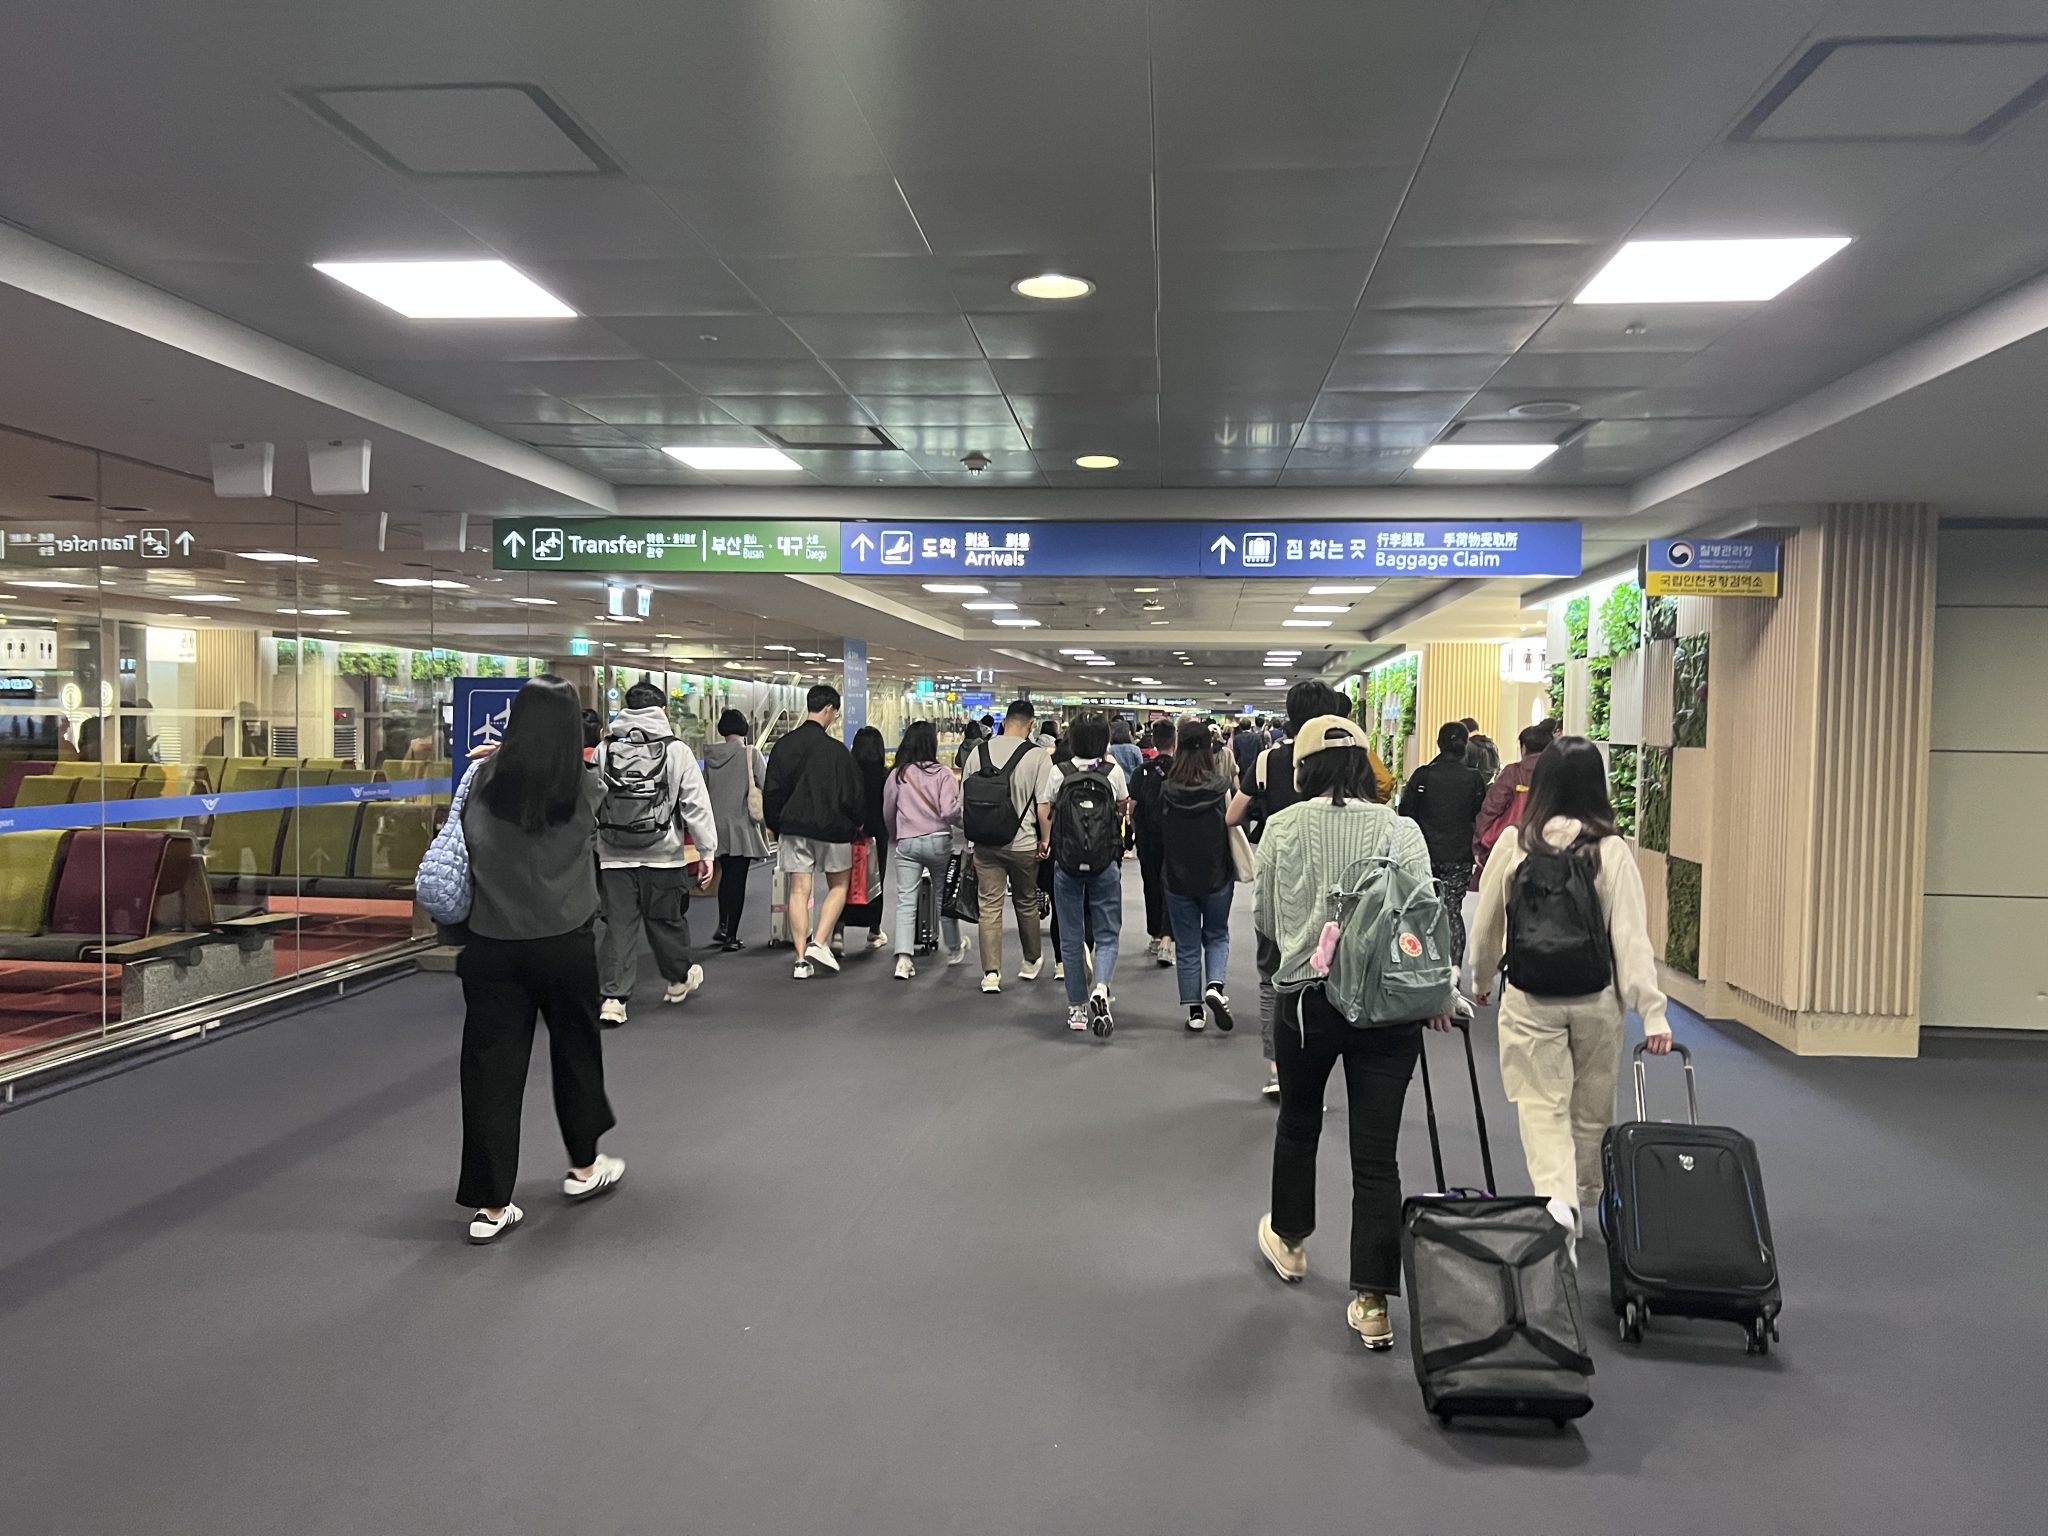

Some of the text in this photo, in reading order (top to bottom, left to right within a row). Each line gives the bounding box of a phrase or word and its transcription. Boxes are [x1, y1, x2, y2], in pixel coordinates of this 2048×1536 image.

[568, 535, 645, 555] Transfer
[711, 535, 742, 556] 부산
[777, 536, 803, 557] 대구
[921, 537, 957, 559] 도착
[1285, 538, 1367, 561] 짐 찾는 곳
[1376, 532, 1519, 548] 行李提取 手荷物受取所
[742, 547, 765, 560] Busan
[805, 547, 828, 562] Daegu
[964, 550, 1026, 567] Arrivals
[1375, 550, 1501, 571] Baggage Claim
[1659, 574, 1764, 588] 국립인천공항검역소
